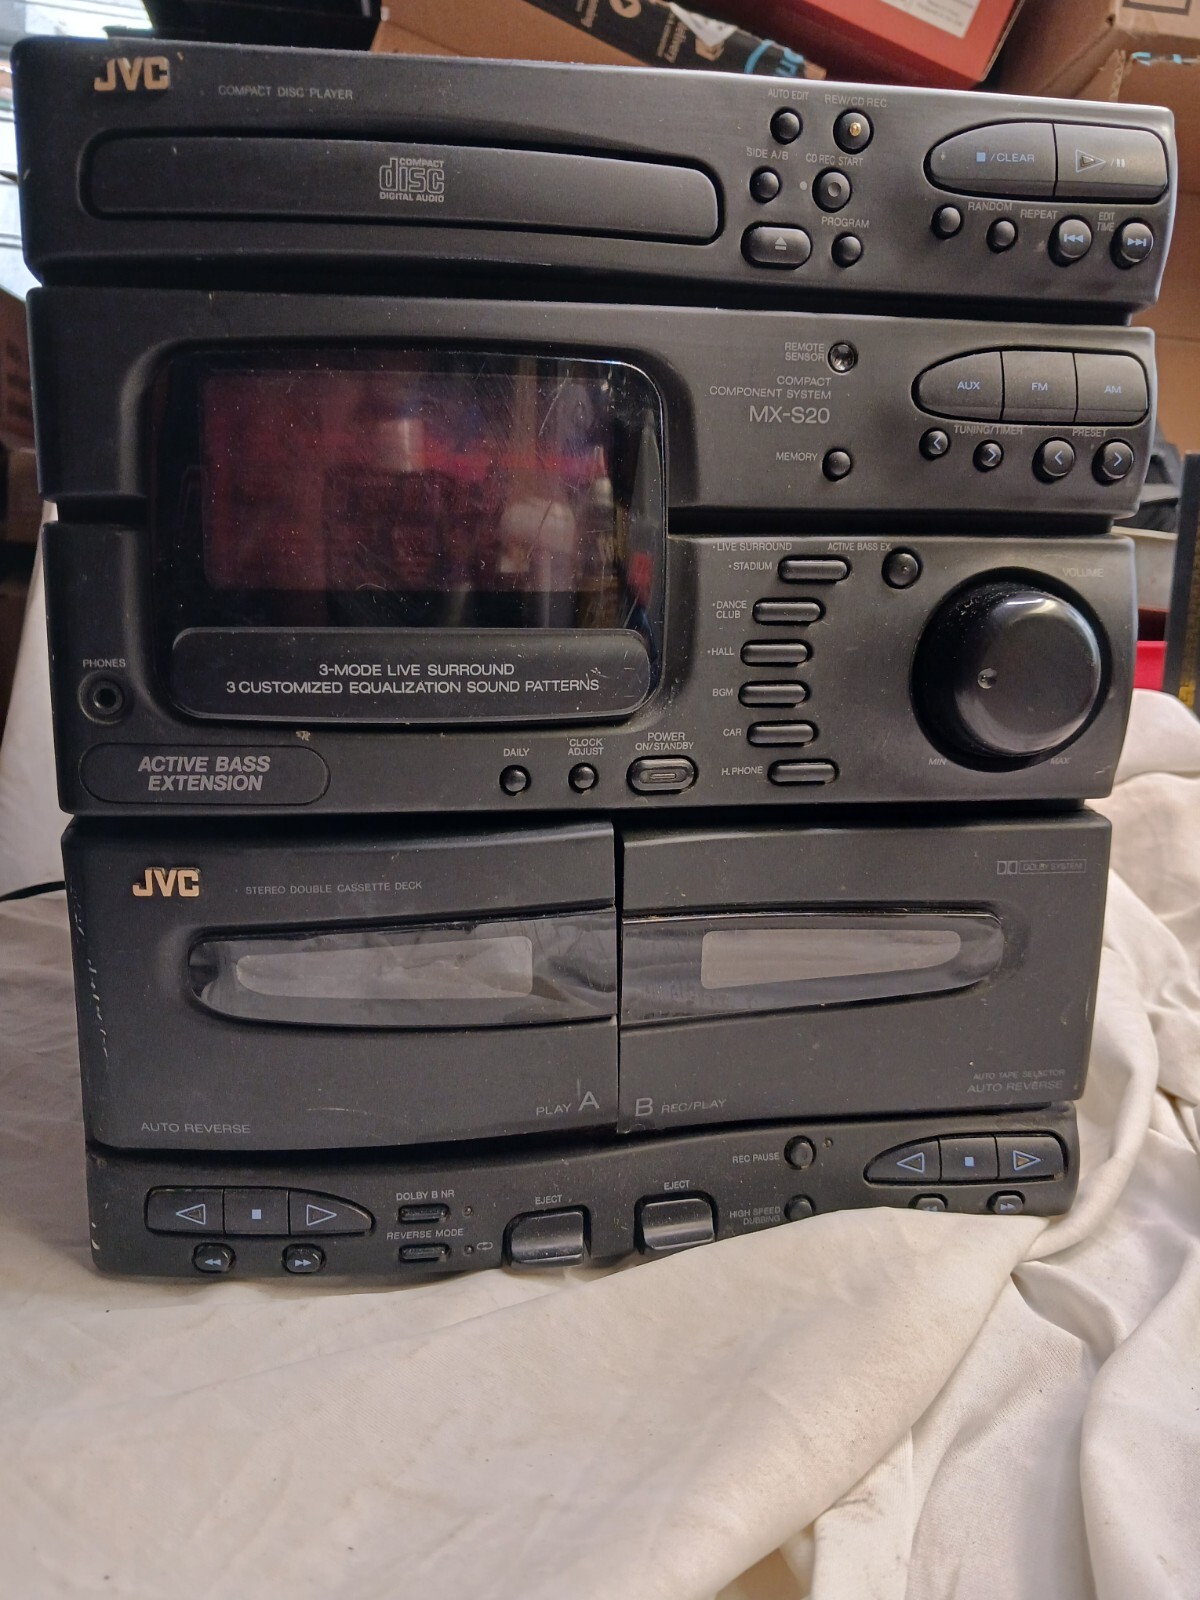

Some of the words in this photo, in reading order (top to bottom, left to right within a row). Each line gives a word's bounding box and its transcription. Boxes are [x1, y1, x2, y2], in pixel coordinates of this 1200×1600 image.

[94, 56, 171, 91] JVC
[218, 85, 272, 97] COMPACT
[277, 86, 304, 98] DISC
[309, 88, 353, 100] PLAYER
[768, 89, 790, 99] AUTO
[791, 90, 809, 100] EDIT
[824, 94, 865, 107] REW/CD
[866, 97, 887, 108] REC
[746, 147, 768, 158] SIDE
[770, 149, 789, 160] A/B
[399, 157, 445, 168] COMPACT
[805, 153, 818, 163] CD
[819, 154, 836, 164] REC
[838, 155, 863, 166] START
[379, 191, 414, 201] DIGITAL
[415, 192, 445, 203] AUDIO
[967, 201, 1013, 211] RANDOM
[1020, 209, 1058, 220] REPEAT
[1098, 212, 1115, 221] EDIT
[821, 216, 870, 229] PROGRAM
[1096, 222, 1115, 232] TIME
[784, 342, 825, 351] REMOTE
[784, 352, 825, 361] SENSOR
[776, 376, 832, 386] COMPACT
[957, 381, 981, 390] AUX
[1031, 383, 1048, 391] FM
[1104, 385, 1122, 394] AM
[709, 386, 783, 398] COMPONENT
[786, 389, 831, 400] SYSTEM
[749, 405, 831, 424] MX-S20
[954, 424, 1024, 435] TUNING/TIMER
[1072, 428, 1108, 438] PRESET
[775, 452, 818, 461] MEMORY
[716, 542, 738, 551] LIVE
[739, 542, 792, 551] SURROUND
[827, 542, 855, 551] ACTIVE
[857, 542, 878, 551] BASS
[733, 562, 773, 571] STADIUM
[1062, 567, 1104, 578] VOLUME
[716, 601, 747, 609] DANCE
[716, 610, 741, 619] CLUB
[711, 647, 735, 656] HALL
[82, 658, 126, 668] PHONES
[318, 663, 382, 677] 3-MODE
[387, 663, 421, 677] LIVE
[427, 663, 515, 676] SURROUND
[238, 681, 343, 694] CUSTOMIZED
[349, 681, 461, 694] EQUALIZATION
[467, 680, 520, 693] SOUND
[525, 679, 600, 692] PATTERNS
[712, 688, 734, 697] BGM
[647, 731, 686, 741] POWER
[722, 728, 742, 737] CAR
[569, 738, 603, 747] CLOCK
[635, 741, 694, 751] ON/STANDBY
[503, 748, 530, 757] DAILY
[567, 747, 605, 756] ADJUST
[137, 756, 209, 772] ACTIVE
[215, 756, 271, 773] BASS
[928, 758, 947, 766] MIN
[1050, 757, 1071, 765] MAX
[147, 775, 263, 791] EXTENSION
[132, 867, 201, 898] JVC
[245, 885, 286, 895] STEREO
[289, 884, 331, 894] DOUBLE
[336, 882, 390, 893] CASSETTE
[394, 881, 423, 890] DECK
[973, 1072, 996, 1080] AUTO
[998, 1071, 1018, 1079] TAPE
[967, 1083, 1002, 1093] AUTO
[1006, 1080, 1063, 1091] REVERSE
[535, 1103, 571, 1116] PLAY
[578, 1091, 600, 1111] A
[635, 1097, 654, 1117] B
[661, 1099, 726, 1114] REC/PLAY
[140, 1122, 180, 1133] AUTO
[184, 1123, 251, 1134] REVERSE
[732, 1154, 750, 1164] REC
[752, 1152, 780, 1162] PAUSE
[664, 1180, 691, 1190] EJECT
[395, 1191, 428, 1201] DOLBY
[431, 1190, 438, 1199] B
[441, 1190, 455, 1198] NR
[535, 1194, 563, 1205] EJECT
[730, 1209, 751, 1219] HIGH
[752, 1206, 781, 1216] SPEED
[743, 1215, 781, 1225] DUBBING
[386, 1229, 432, 1240] REVERSE
[435, 1228, 464, 1238] MODE
